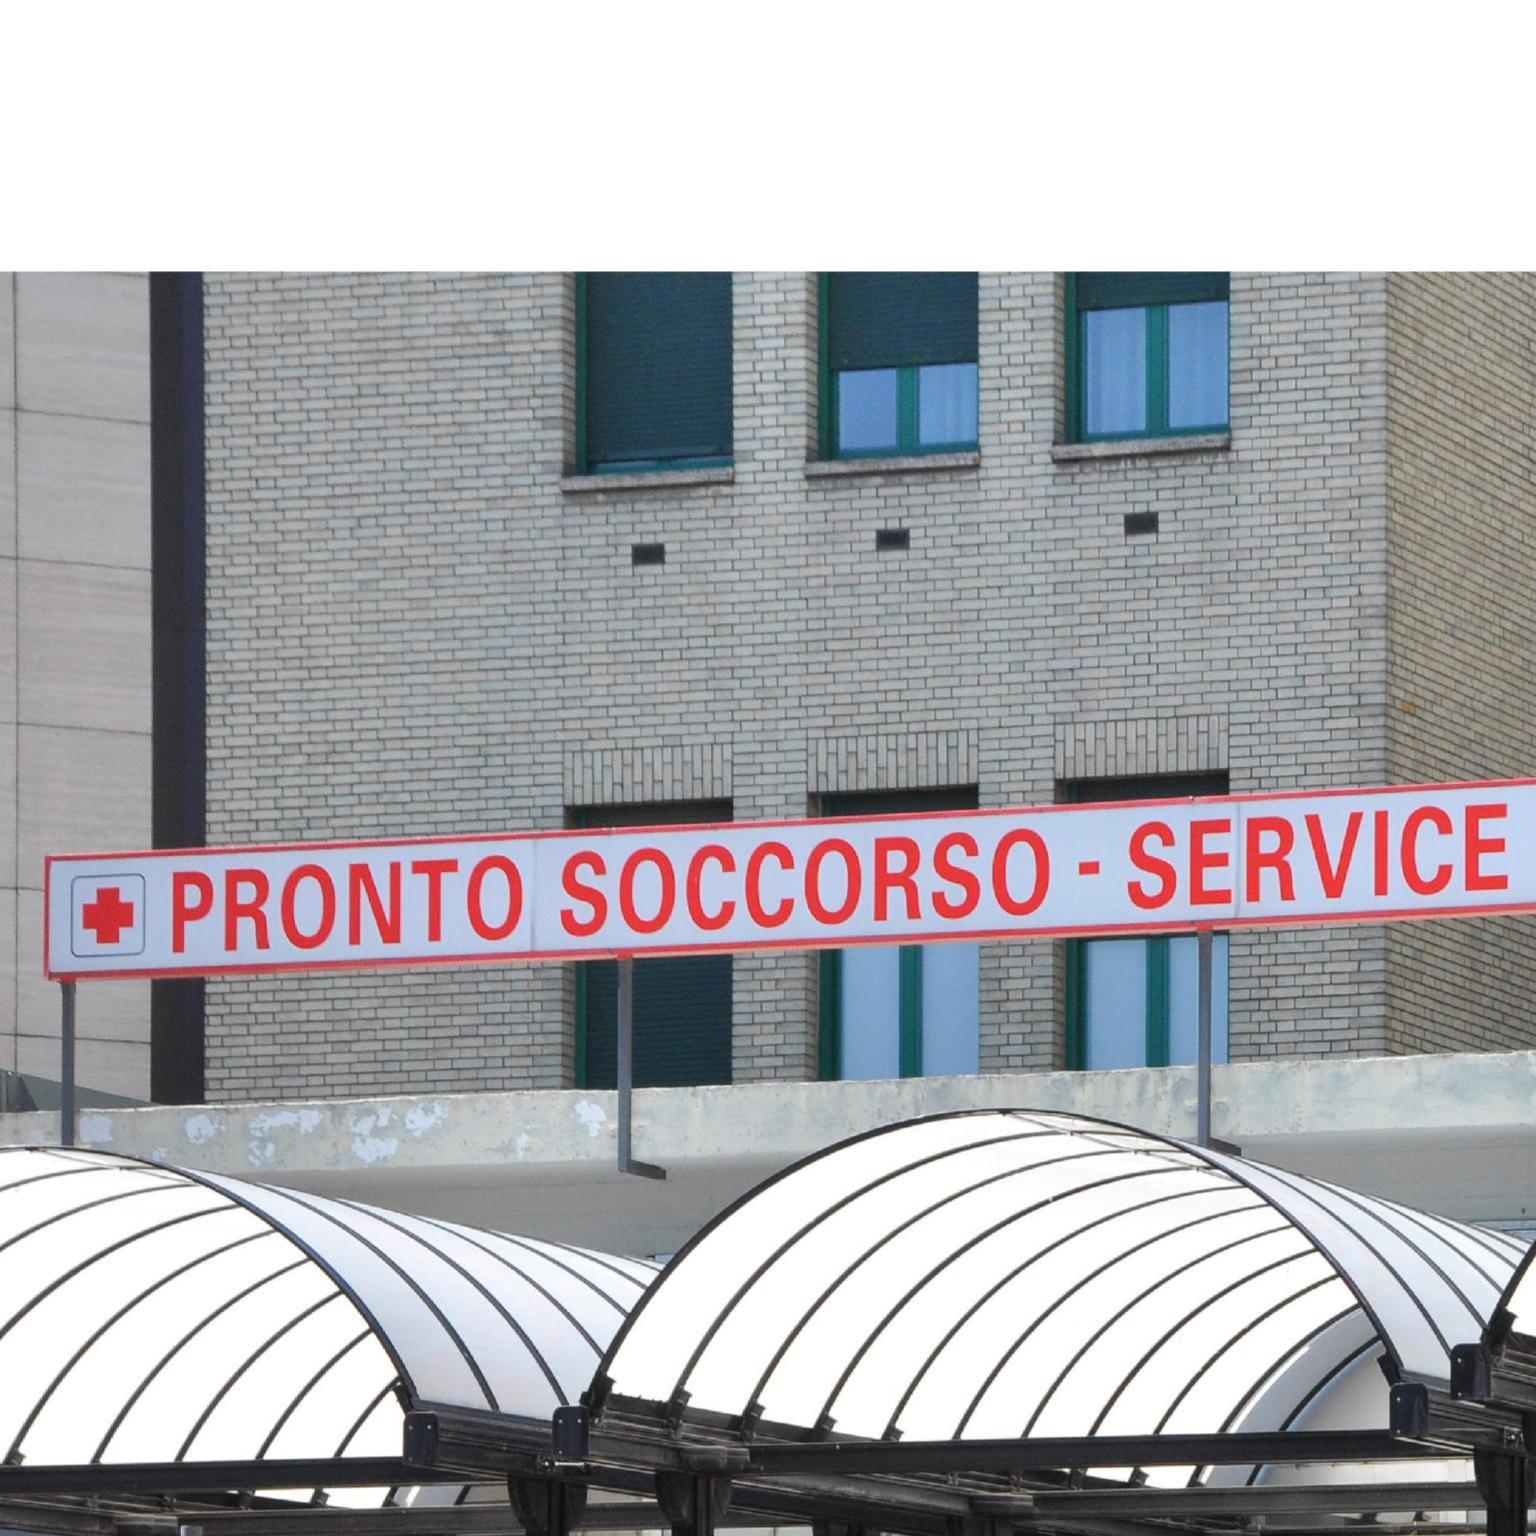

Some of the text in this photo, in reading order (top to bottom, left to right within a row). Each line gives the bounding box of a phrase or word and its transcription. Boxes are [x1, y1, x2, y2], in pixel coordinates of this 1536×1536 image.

[173, 856, 522, 952] PRONTO
[561, 829, 1050, 936] SOCCORSO
[1078, 862, 1100, 874] -
[1128, 804, 1508, 909] SERVICE
